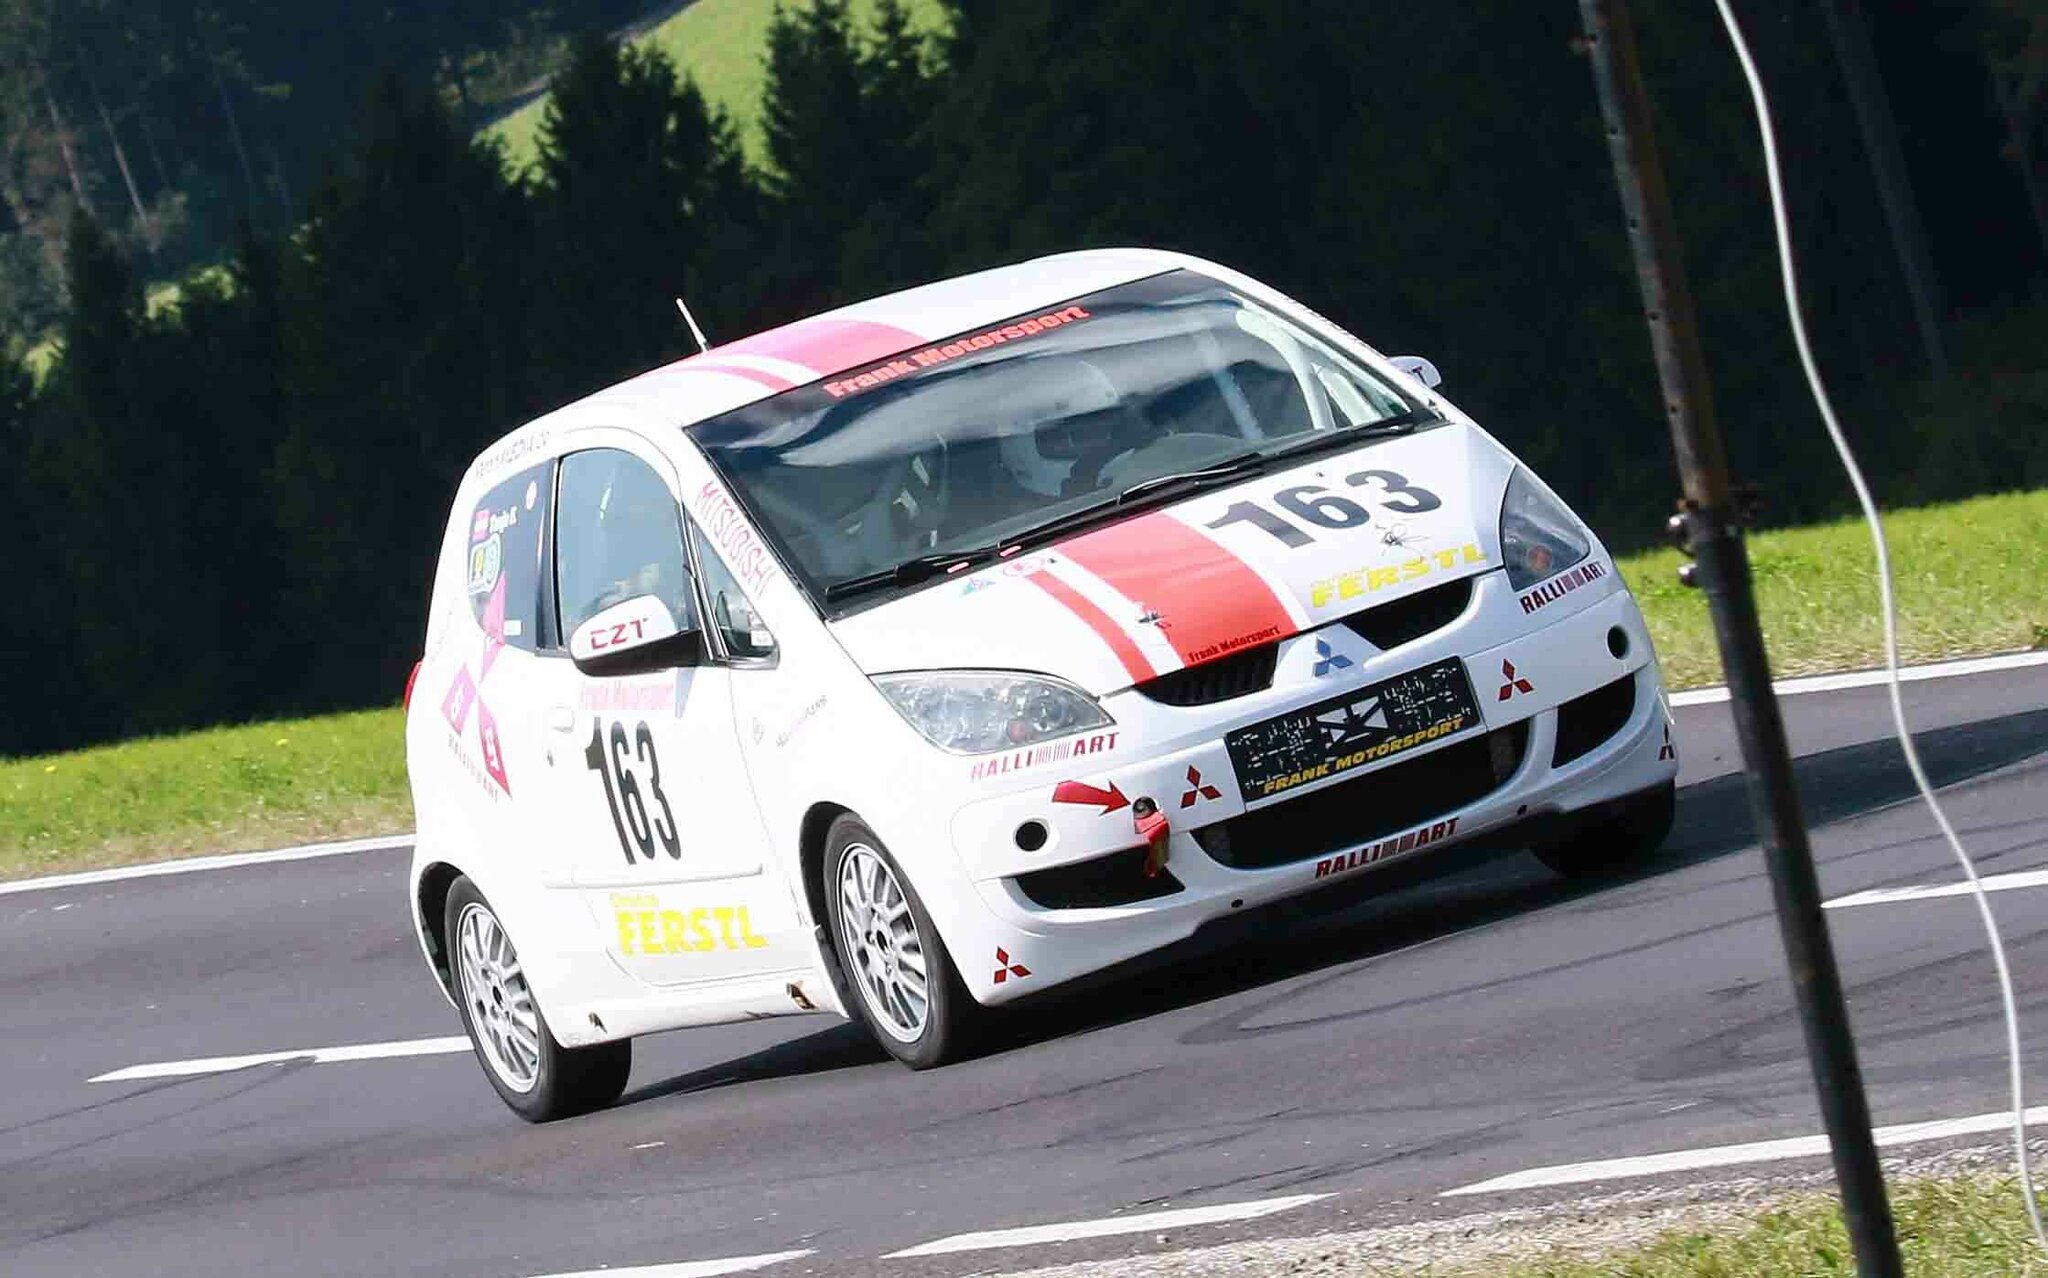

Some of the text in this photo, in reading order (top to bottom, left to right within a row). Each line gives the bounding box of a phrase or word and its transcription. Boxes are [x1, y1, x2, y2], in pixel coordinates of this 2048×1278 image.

[823, 304, 1091, 398] Frank Motorsport
[694, 479, 777, 597] MITSUBISHI
[1202, 469, 1442, 549] 163
[1311, 543, 1488, 609] FERSTL
[590, 617, 648, 650] CZT
[1219, 624, 1281, 653] Motorsport
[584, 716, 682, 865] 163
[1263, 716, 1465, 795] FRANK MOTORSPORT
[615, 905, 769, 957] FERSTL
